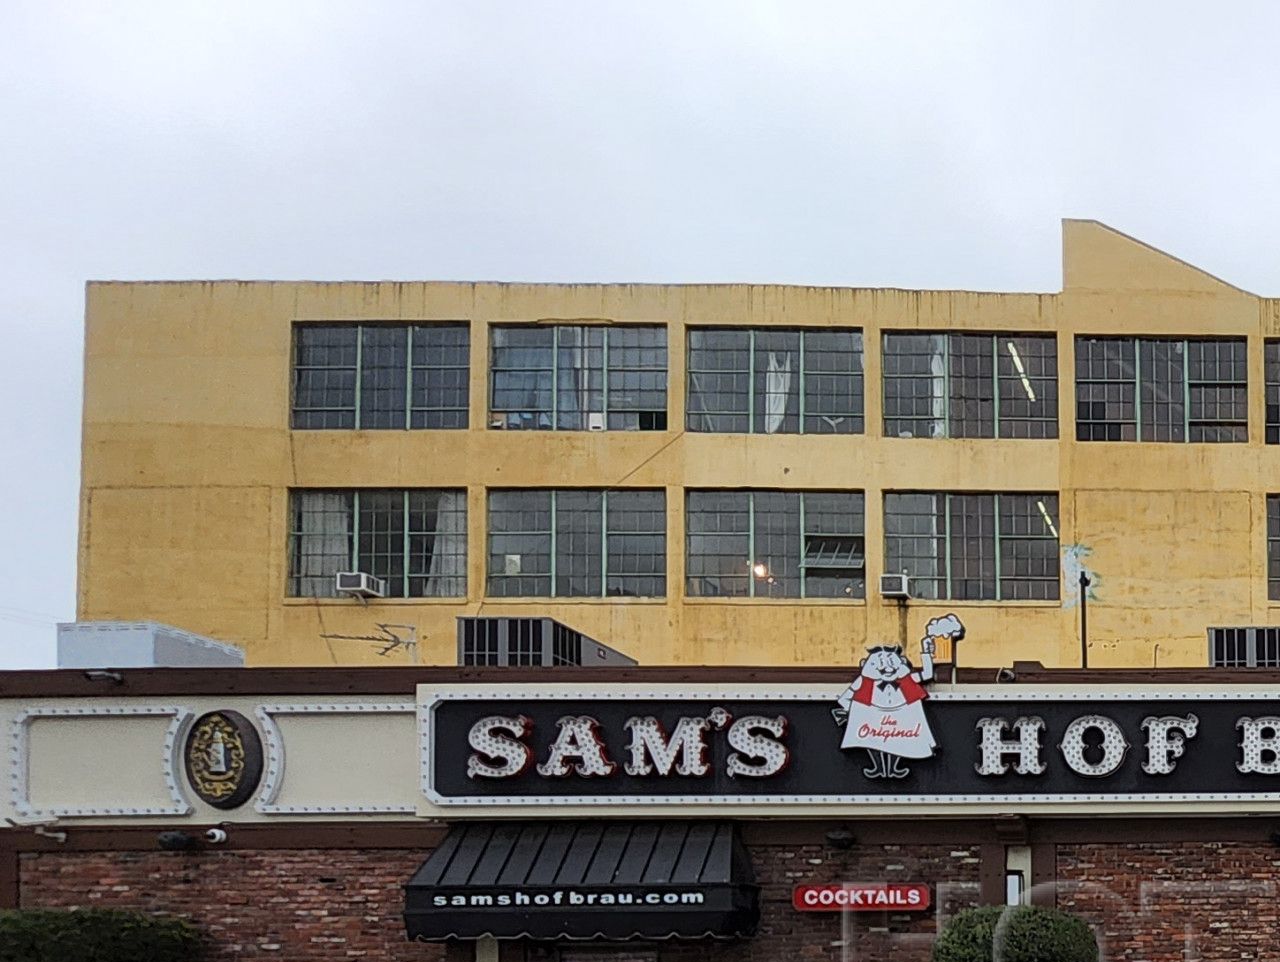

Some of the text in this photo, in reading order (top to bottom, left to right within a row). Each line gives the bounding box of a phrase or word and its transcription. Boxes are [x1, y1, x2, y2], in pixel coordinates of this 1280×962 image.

[880, 714, 897, 726] the
[858, 723, 921, 743] Original
[467, 706, 790, 780] SAM'S
[973, 712, 1200, 777] HOF
[432, 891, 705, 907] samshofbrau.com
[803, 889, 921, 906] COCKTAILS
